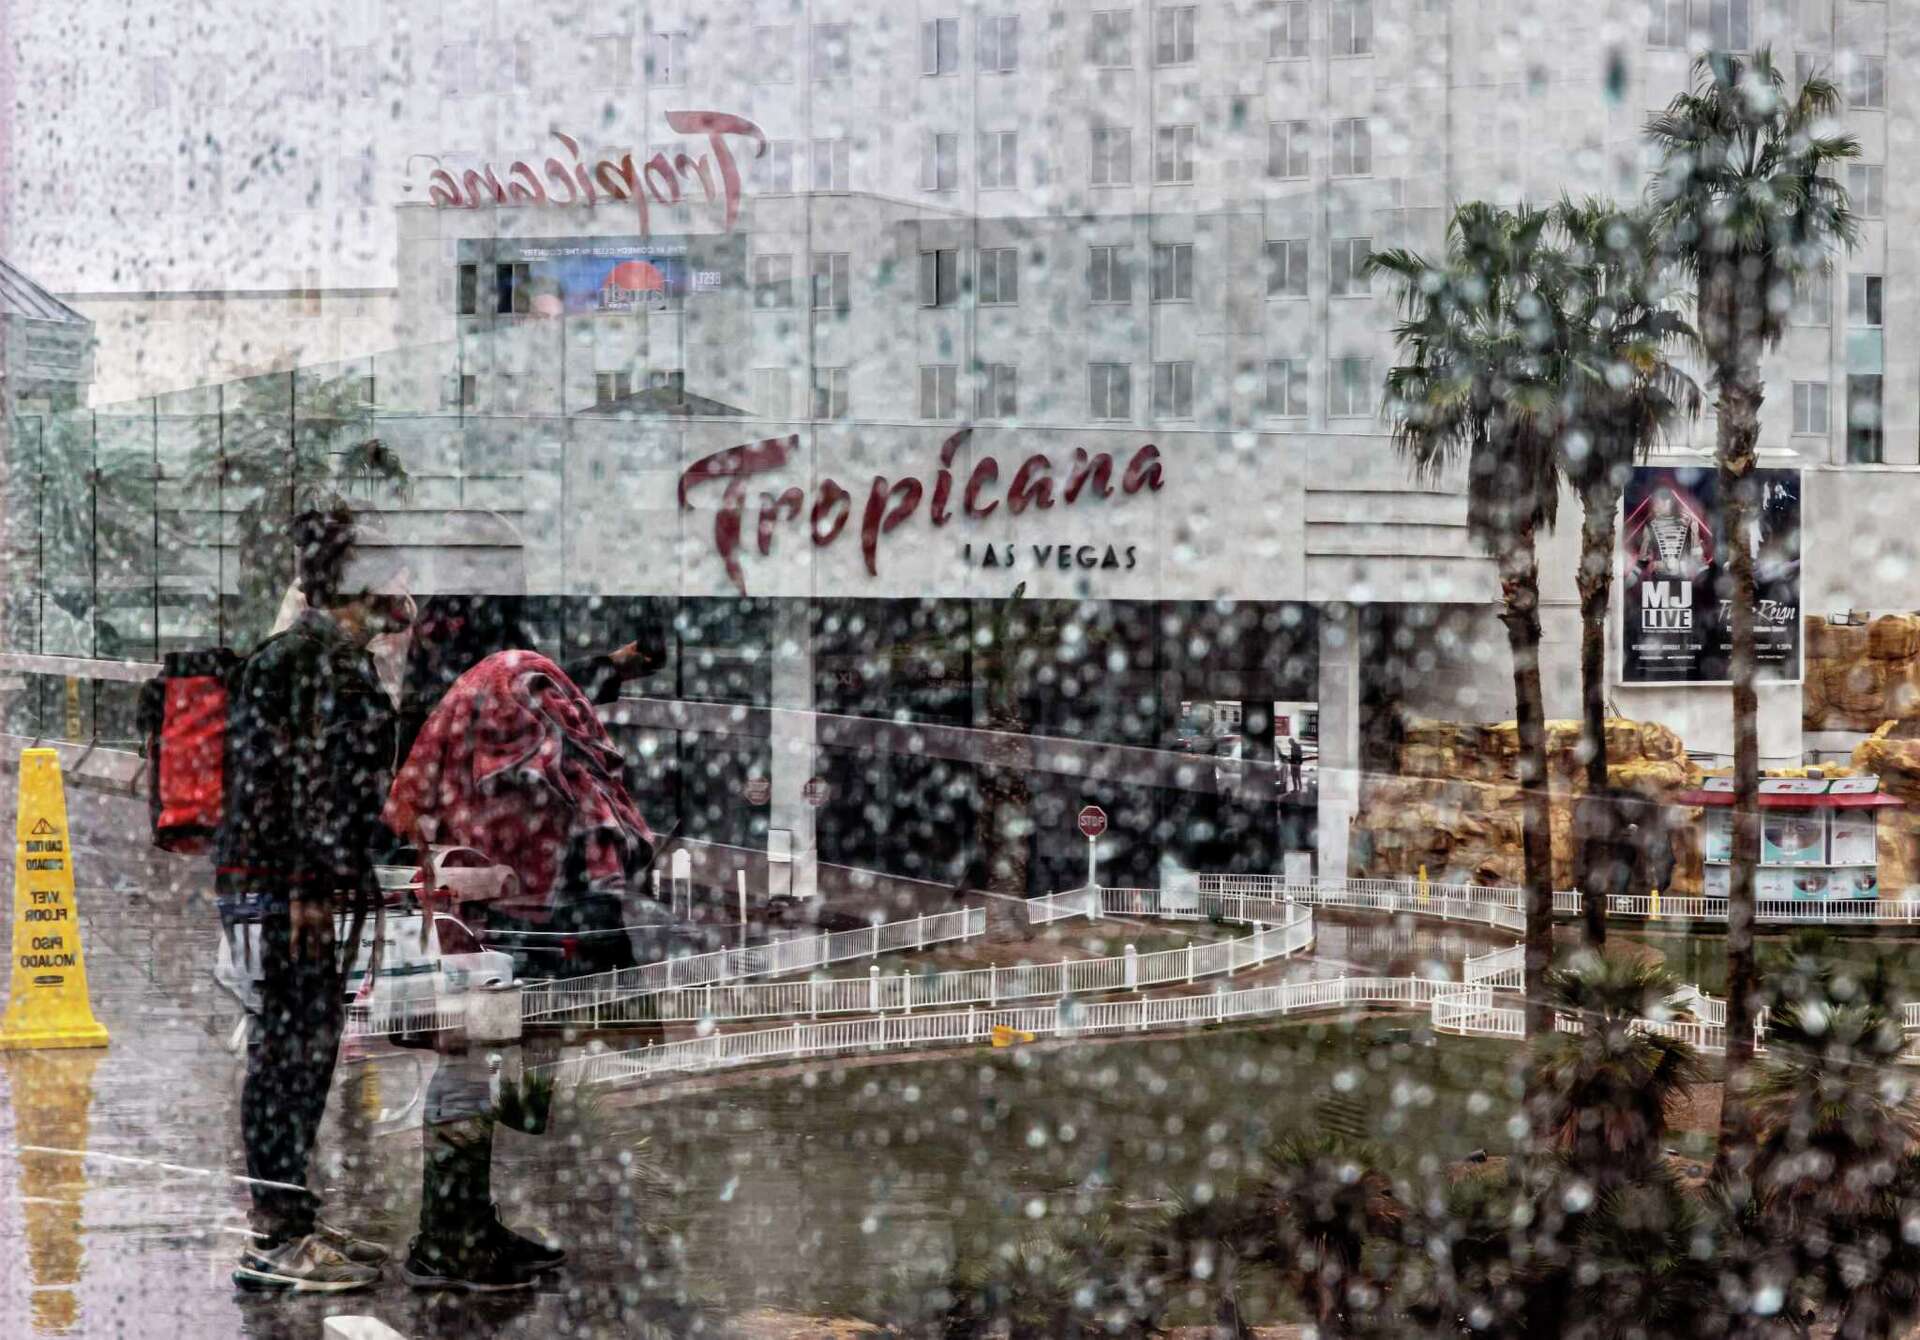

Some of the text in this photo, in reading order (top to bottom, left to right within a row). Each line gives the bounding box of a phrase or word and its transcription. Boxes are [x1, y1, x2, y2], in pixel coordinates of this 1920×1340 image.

[677, 428, 1164, 596] Tropicana
[1034, 544, 1136, 569] VEGAS
[1641, 580, 1692, 608] MJ
[1644, 609, 1690, 628] LIVE
[1758, 599, 1796, 625] Reign
[1080, 815, 1105, 827] STOP
